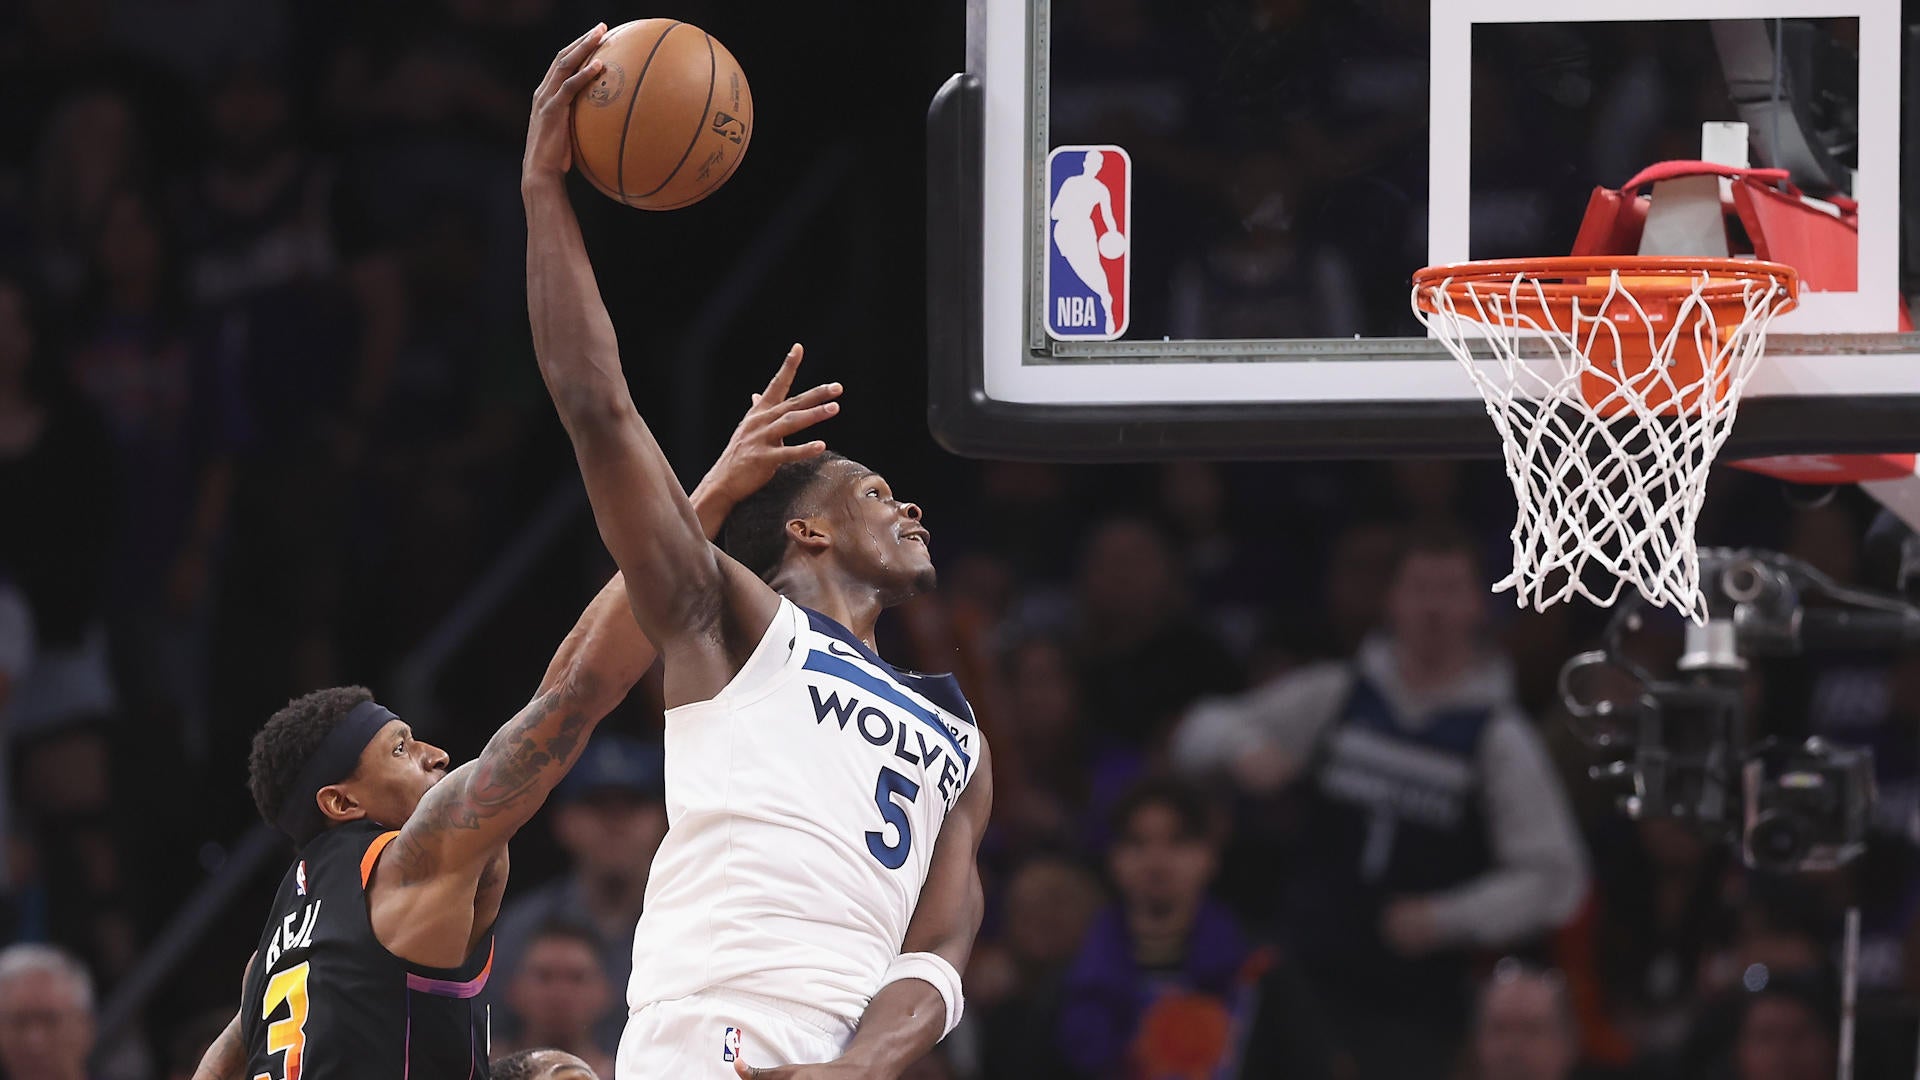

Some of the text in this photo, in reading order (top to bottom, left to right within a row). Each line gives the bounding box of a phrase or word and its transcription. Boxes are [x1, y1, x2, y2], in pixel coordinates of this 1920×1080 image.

[1056, 296, 1097, 327] NBA
[864, 765, 920, 870] 5
[253, 960, 310, 1080] 3
